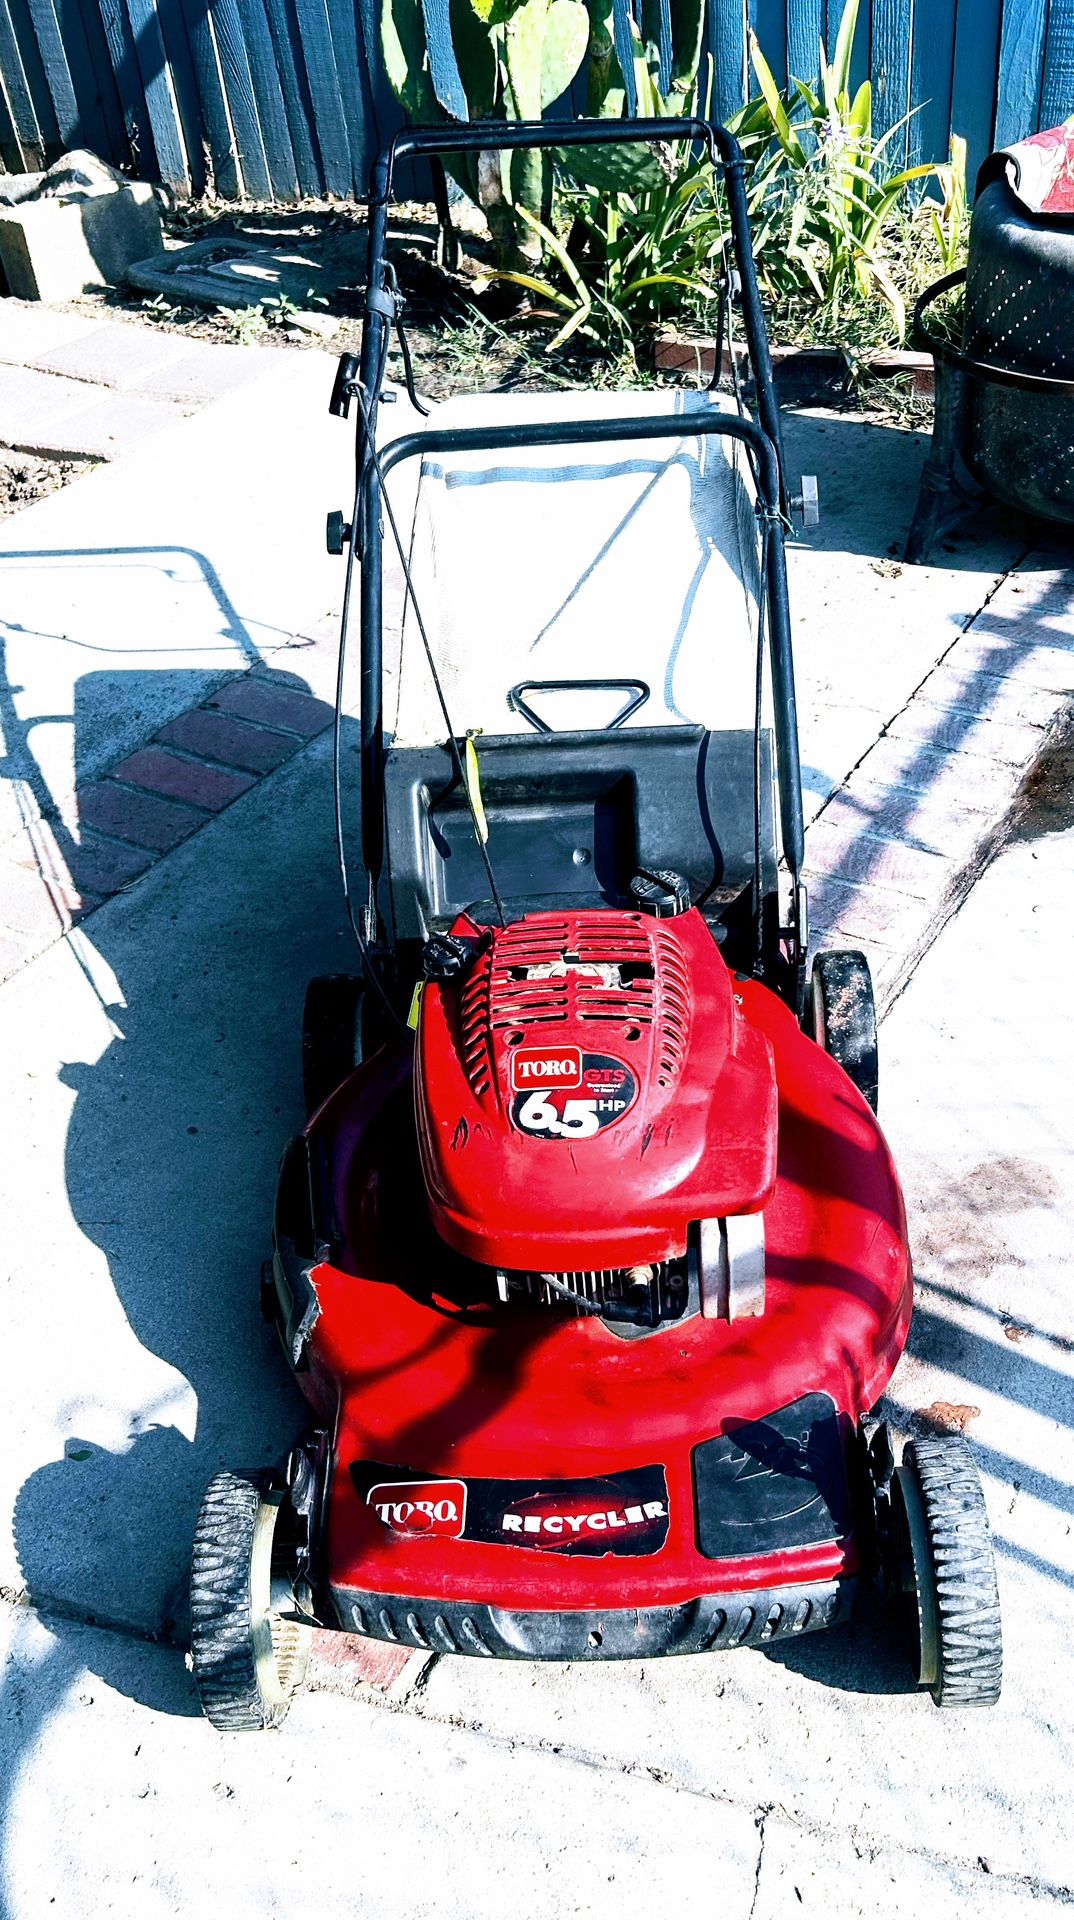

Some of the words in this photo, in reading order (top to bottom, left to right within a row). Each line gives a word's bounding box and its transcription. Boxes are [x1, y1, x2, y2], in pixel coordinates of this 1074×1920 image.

[518, 1059, 578, 1078] TORO
[583, 1069, 626, 1082] GTS
[518, 1090, 600, 1138] 6.5
[599, 1100, 626, 1111] HP
[502, 1501, 668, 1533] RECYCLER
